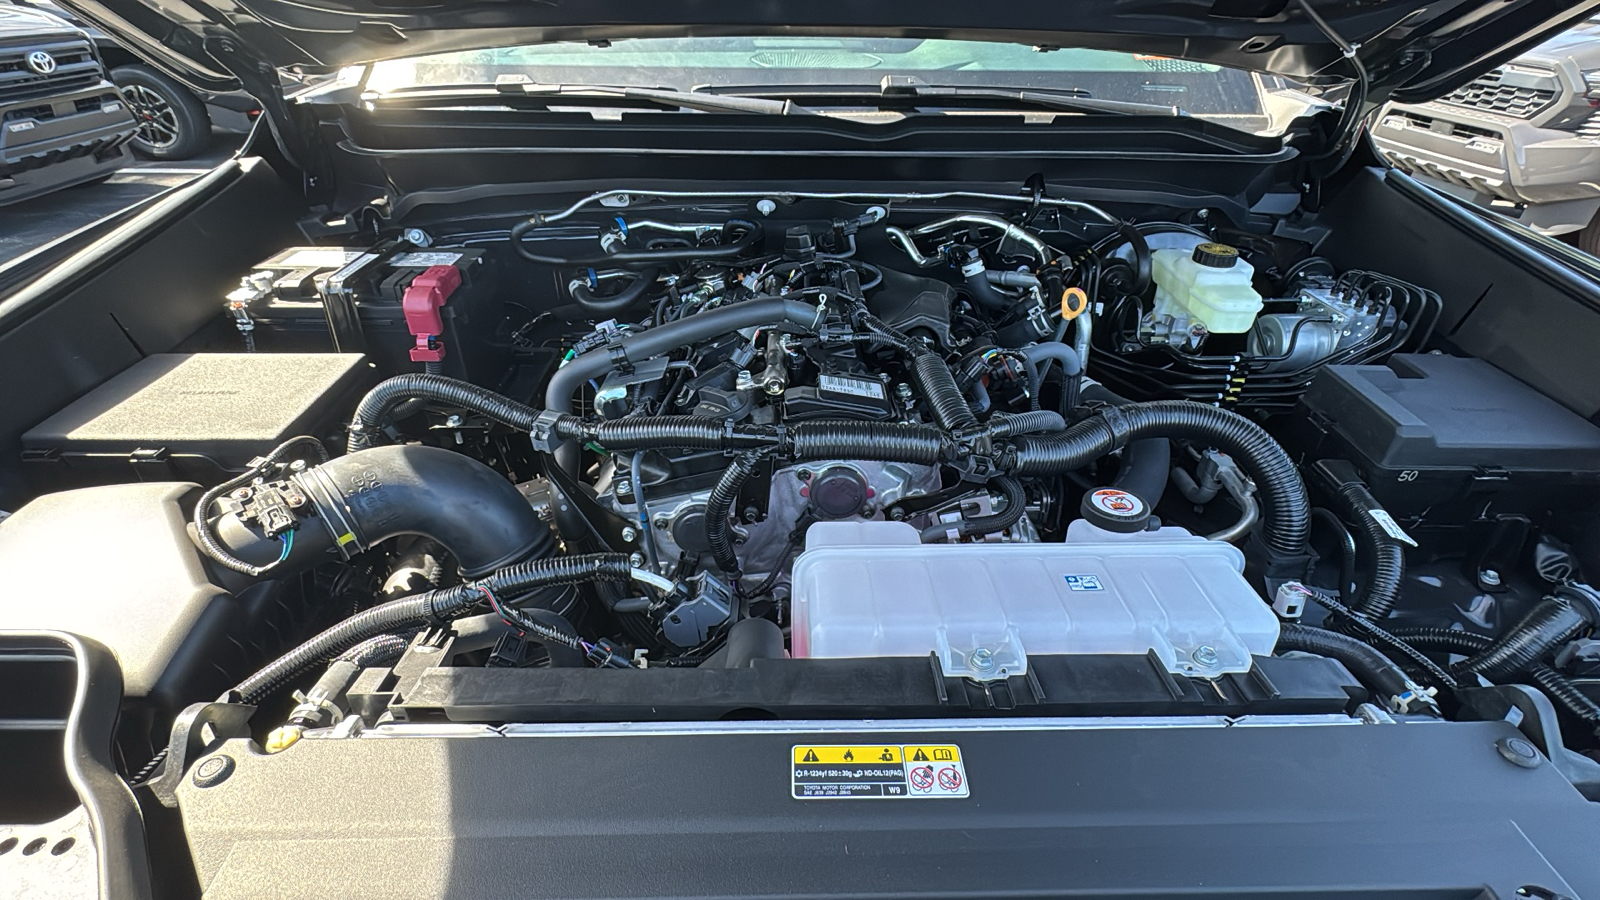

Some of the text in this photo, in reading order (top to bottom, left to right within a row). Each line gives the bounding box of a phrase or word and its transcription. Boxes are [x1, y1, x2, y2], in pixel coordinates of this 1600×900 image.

[1397, 470, 1419, 482] 50
[803, 769, 827, 778] R-1234yf
[888, 786, 901, 794] W9
